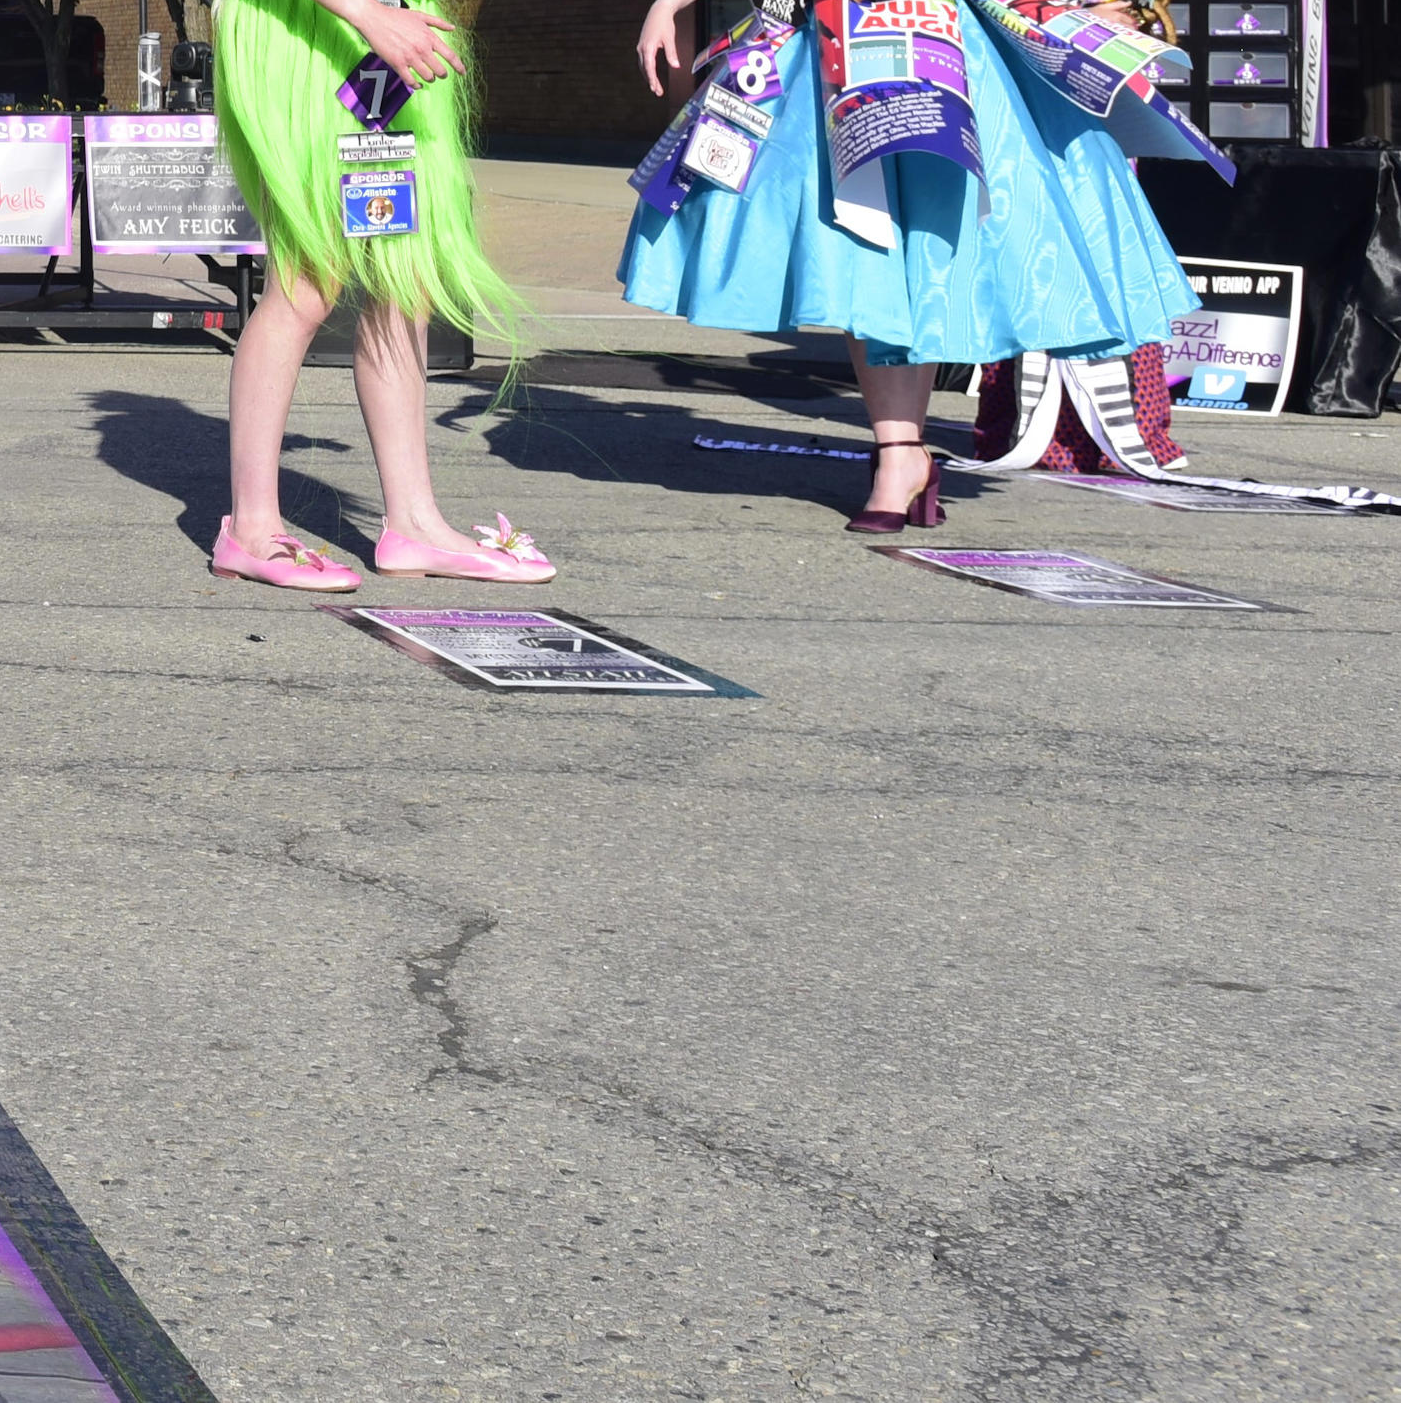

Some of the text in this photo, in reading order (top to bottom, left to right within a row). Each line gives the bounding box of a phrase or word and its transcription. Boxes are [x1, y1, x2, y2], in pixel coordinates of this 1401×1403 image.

[736, 50, 772, 96] 8
[359, 69, 388, 119] 7
[1301, 35, 1320, 139] VOTING
[110, 123, 218, 138] SPONSO
[358, 134, 395, 147] Hunter
[92, 165, 205, 177] TWIN SHUTTERBUG
[350, 173, 405, 184] SPONSOR
[363, 188, 397, 197] Allstate
[110, 201, 245, 215] Award winning photographer
[123, 216, 238, 235] AMY FEICK
[1212, 276, 1281, 294] VENMO APP
[1175, 398, 1249, 410] venmo
